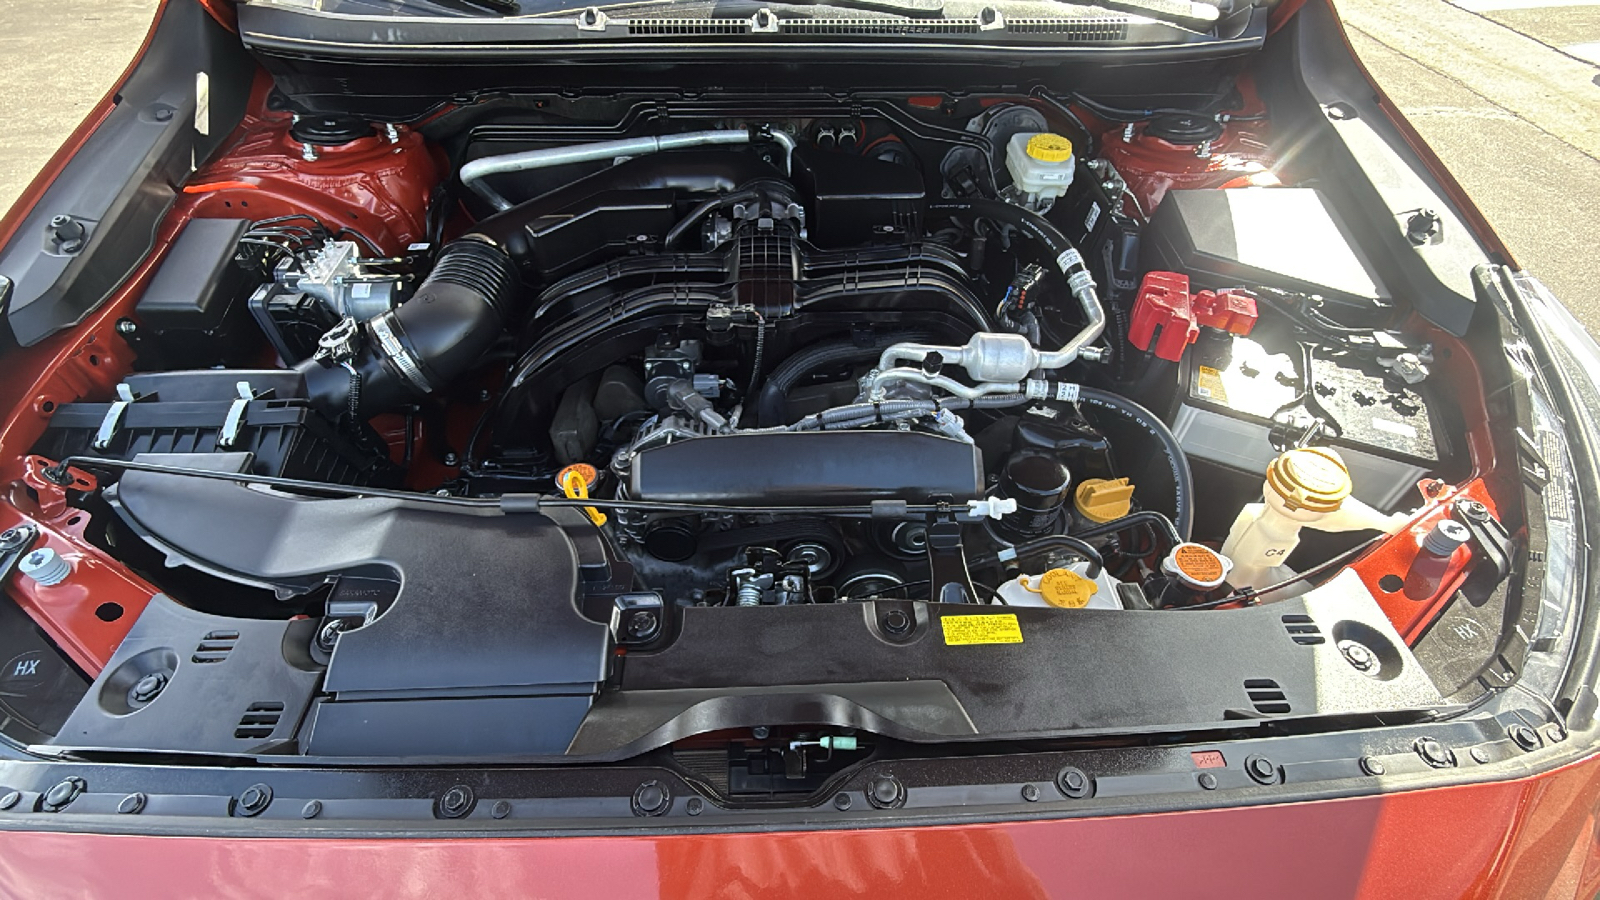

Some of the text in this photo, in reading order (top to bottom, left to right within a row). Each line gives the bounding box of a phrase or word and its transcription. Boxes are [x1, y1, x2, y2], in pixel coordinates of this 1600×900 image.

[1265, 548, 1286, 557] C4
[1453, 623, 1479, 640] HX
[13, 659, 41, 676] HX
